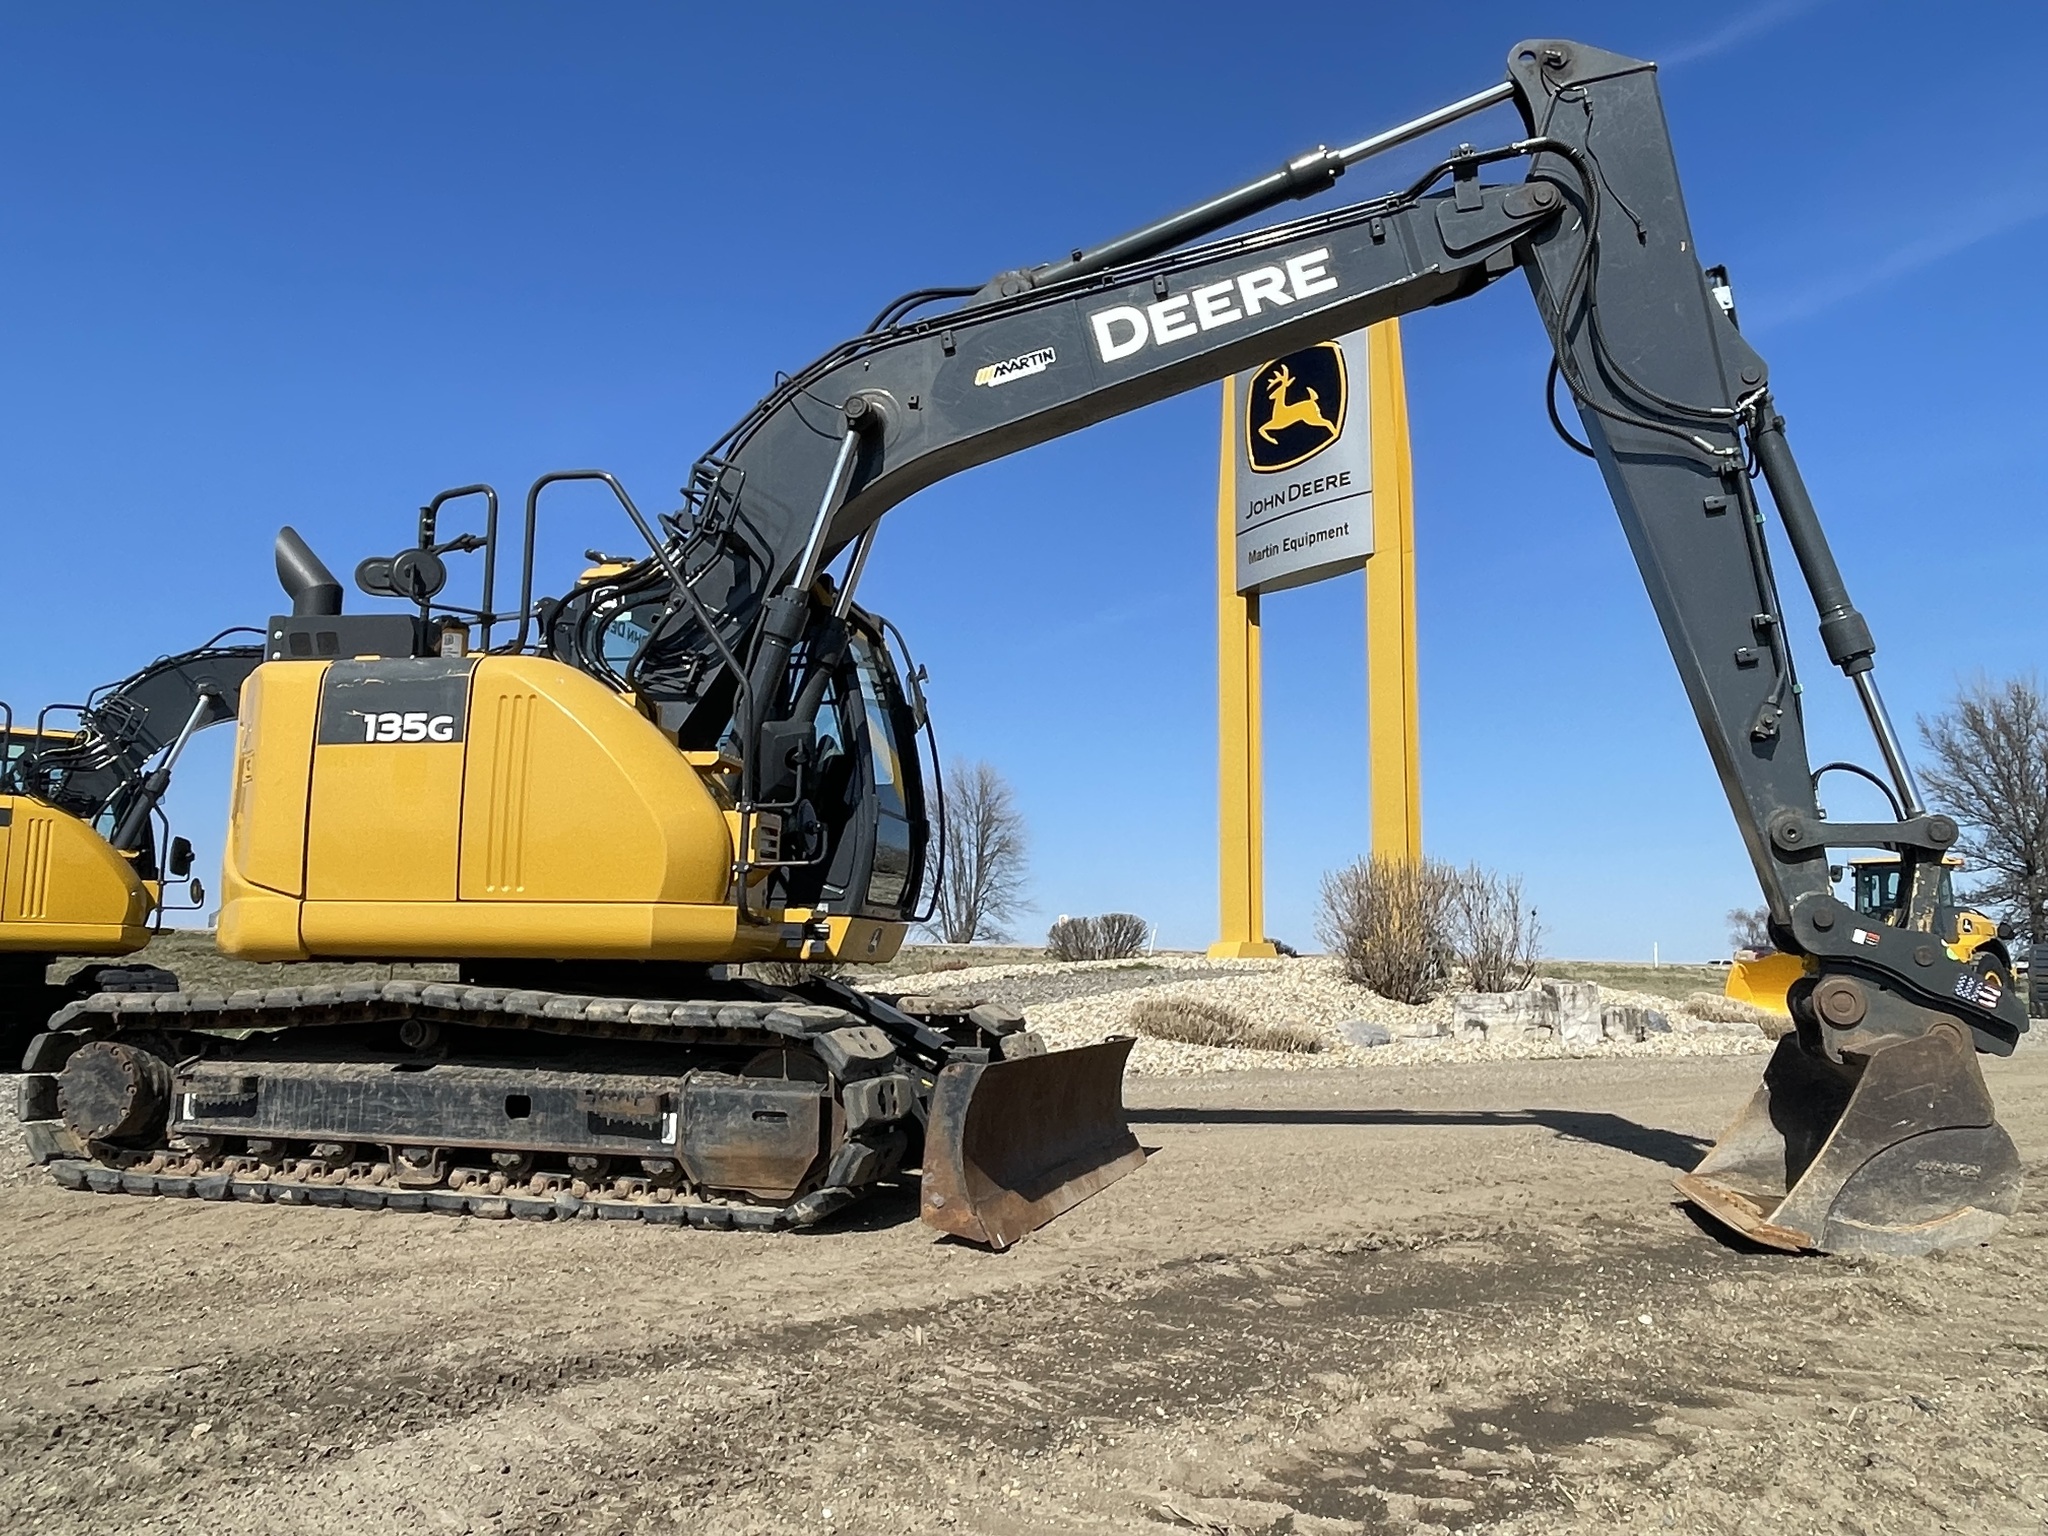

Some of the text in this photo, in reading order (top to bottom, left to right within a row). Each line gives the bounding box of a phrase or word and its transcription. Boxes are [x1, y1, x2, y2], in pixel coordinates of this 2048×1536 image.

[1091, 248, 1338, 363] DEERE
[993, 349, 1054, 378] MARTIN
[1245, 471, 1351, 519] JOHN DEERE
[1248, 522, 1349, 564] Martin Equipment
[364, 711, 454, 742] 135G
